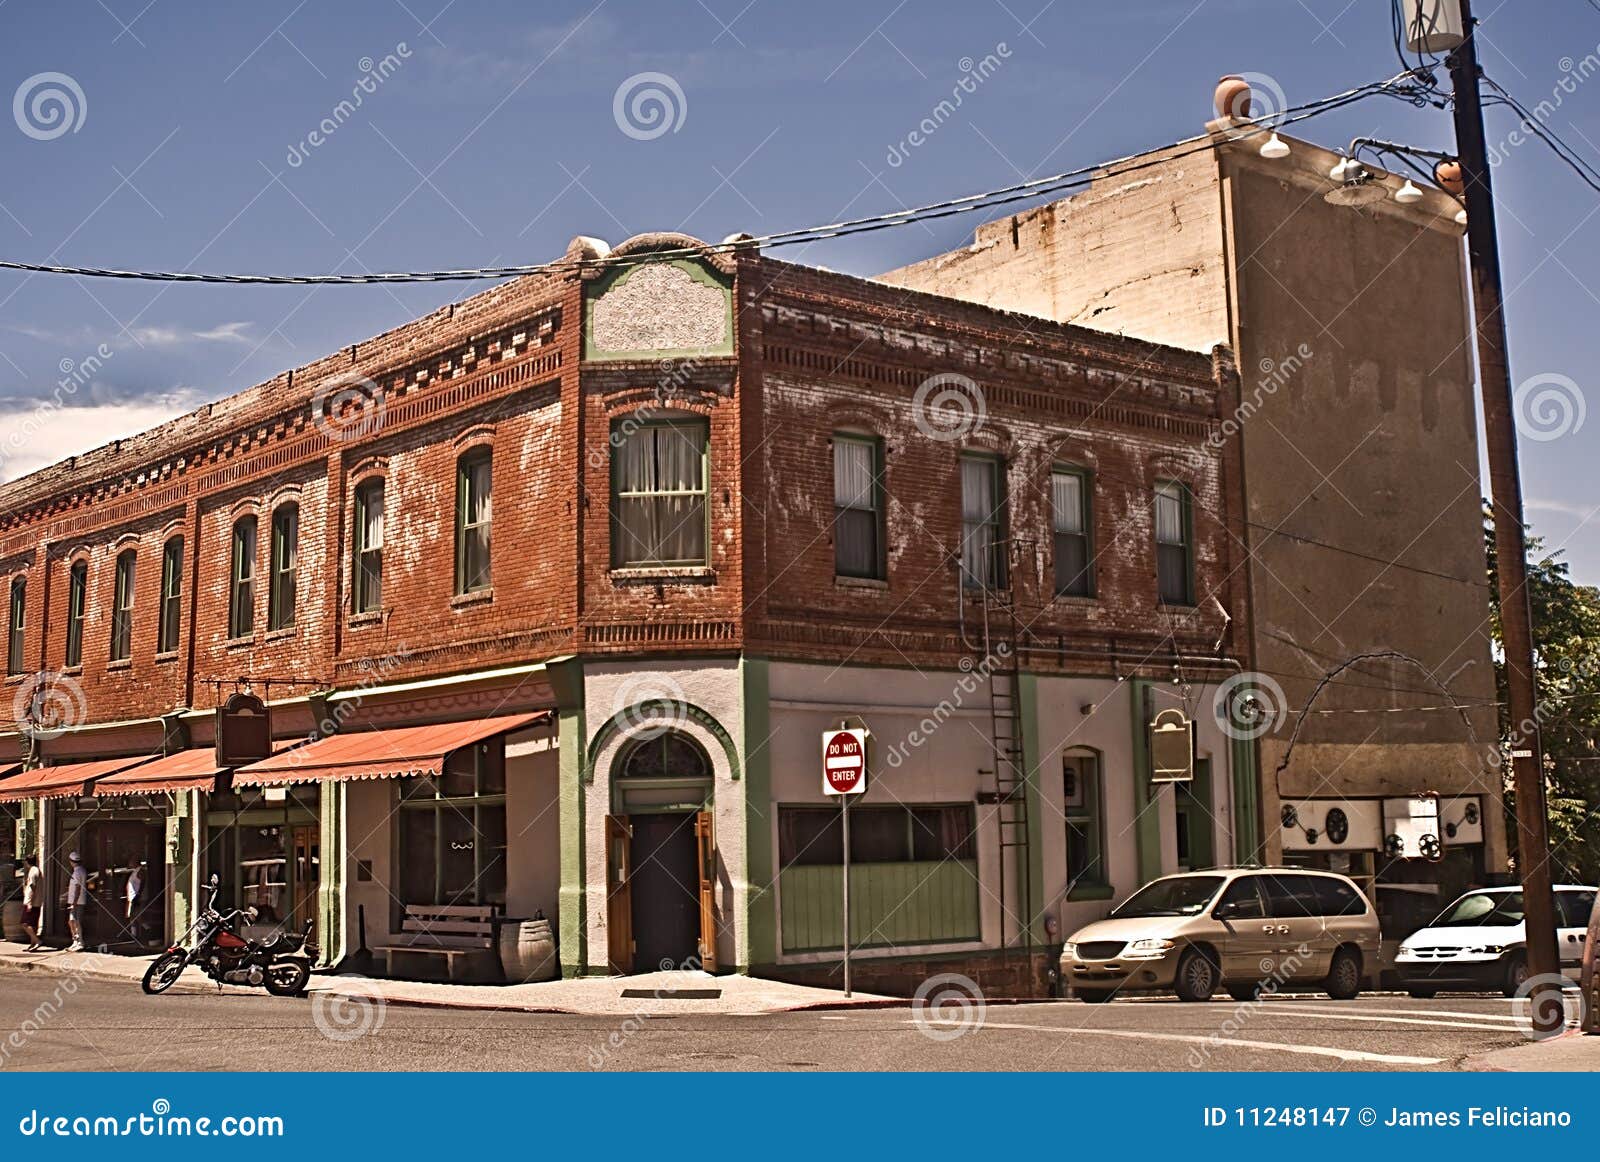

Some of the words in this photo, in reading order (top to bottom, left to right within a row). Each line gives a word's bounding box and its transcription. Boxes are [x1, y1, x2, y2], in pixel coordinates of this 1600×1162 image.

[829, 744, 840, 754] DO
[843, 743, 857, 754] NOT
[832, 770, 856, 782] ENTER
